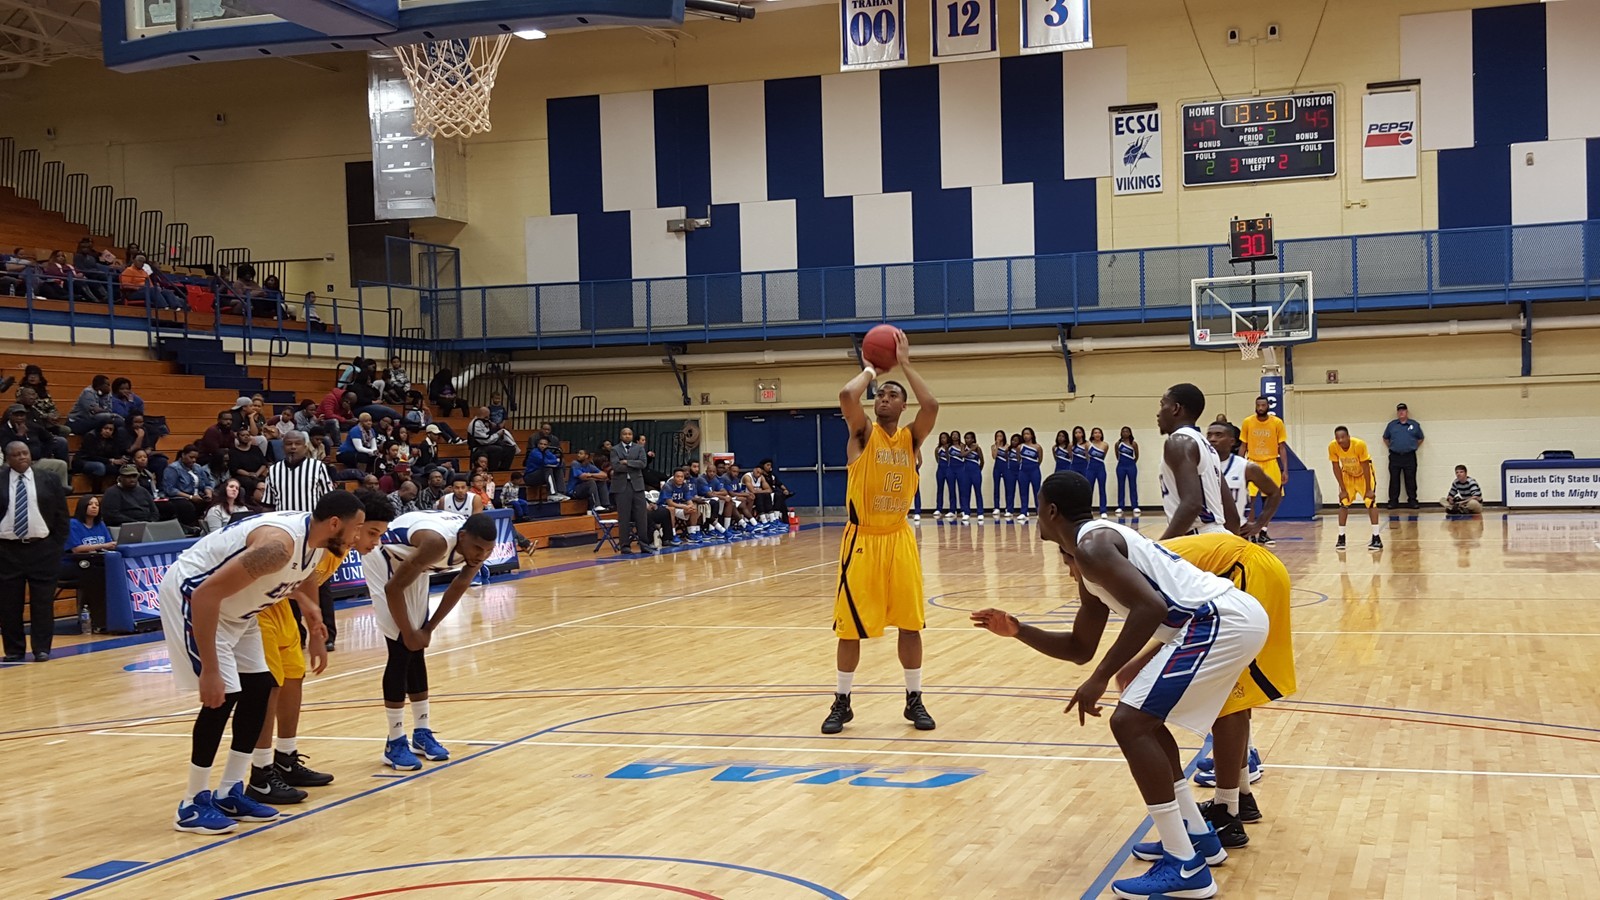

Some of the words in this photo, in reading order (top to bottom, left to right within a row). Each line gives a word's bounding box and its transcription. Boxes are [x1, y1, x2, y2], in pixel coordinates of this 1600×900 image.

[947, 0, 981, 38] 12
[1044, 0, 1068, 27] 3
[849, 8, 896, 47] 00
[1296, 96, 1333, 108] VISITOR
[1188, 107, 1215, 118] HOME
[1234, 101, 1289, 124] 13:51
[1305, 109, 1329, 128] 45
[1115, 113, 1159, 135] ECSU
[1368, 121, 1414, 134] PEPSI
[1239, 133, 1264, 142] PERIOD
[1266, 128, 1276, 143] 2
[1295, 131, 1319, 141] BONUS
[1198, 140, 1221, 149] BONUS
[1300, 143, 1322, 152] FOULS
[1195, 152, 1216, 161] FOULS
[1241, 156, 1276, 166] TIMEOUTS
[1278, 153, 1289, 170] 2
[1229, 157, 1239, 174] 3
[1250, 164, 1267, 172] LEFT
[1116, 174, 1161, 191] VIKINGS
[1239, 234, 1266, 257] 30
[763, 390, 775, 399] EXIT
[884, 472, 903, 493] 12
[1509, 475, 1546, 484] Elizabeth
[1549, 475, 1565, 485] City
[1567, 474, 1590, 483] State
[1514, 489, 1538, 498] Home
[1540, 489, 1549, 498] of
[1552, 489, 1565, 498] the
[1568, 488, 1598, 499] Mighty
